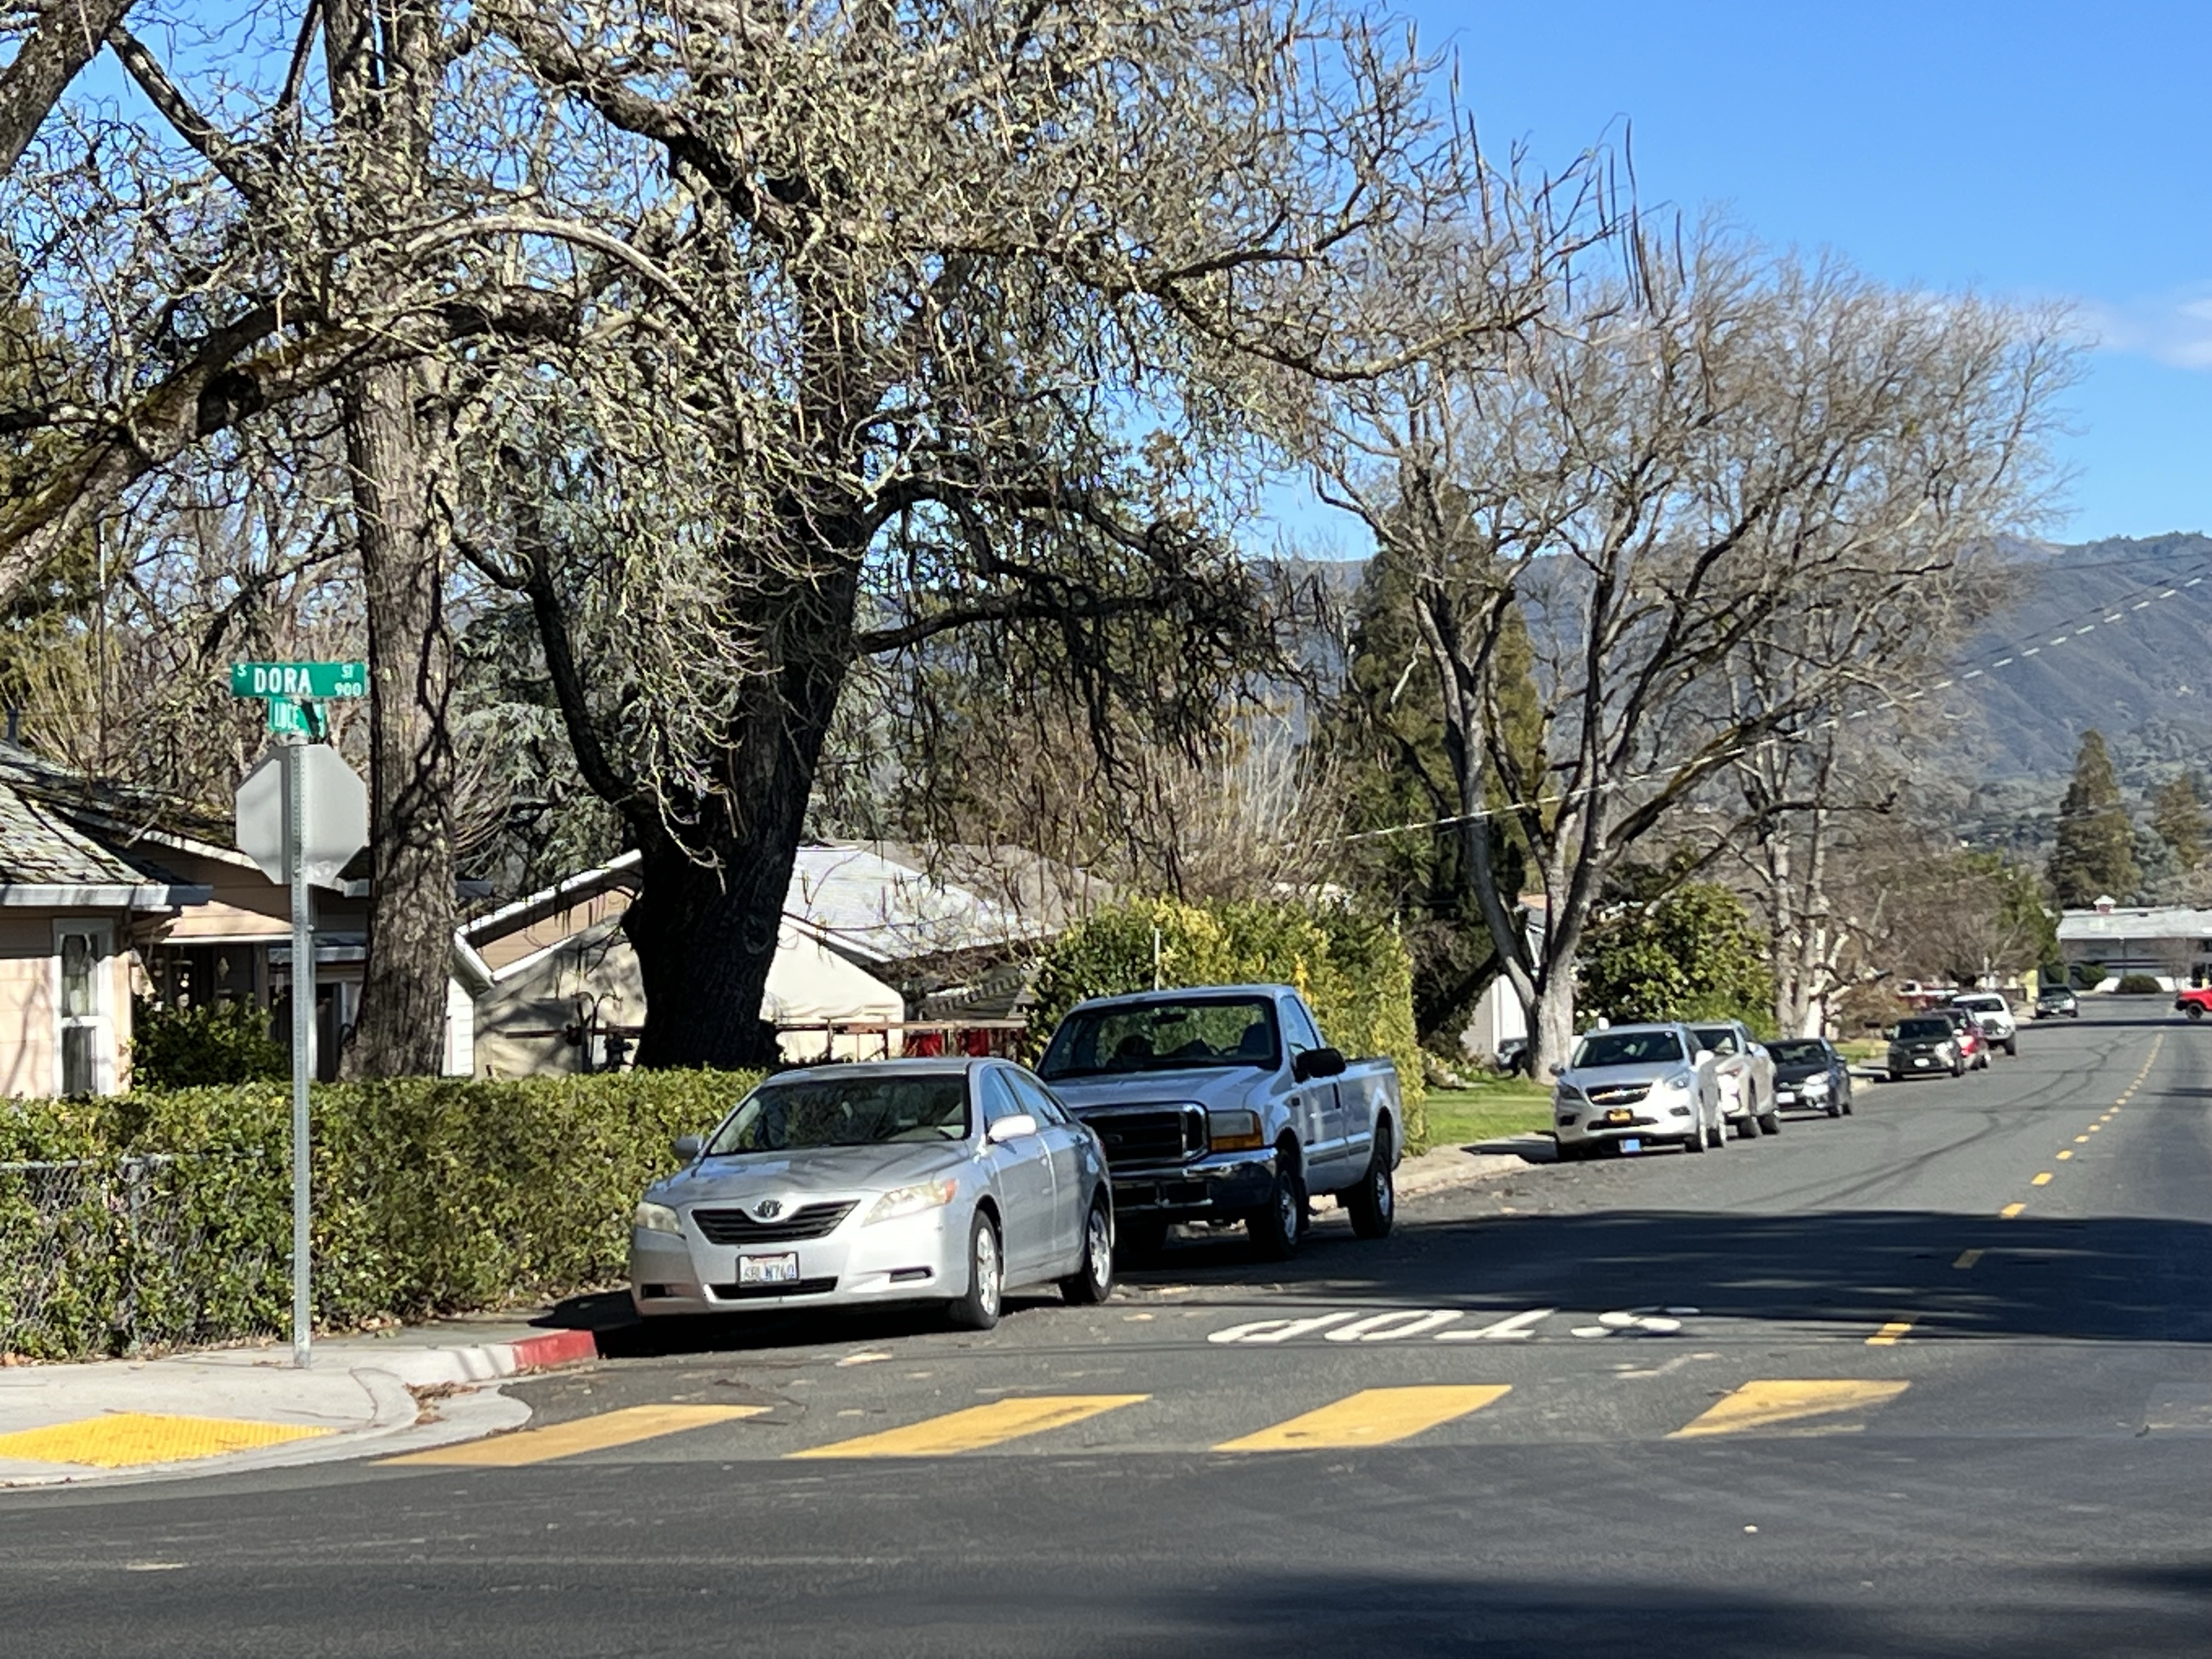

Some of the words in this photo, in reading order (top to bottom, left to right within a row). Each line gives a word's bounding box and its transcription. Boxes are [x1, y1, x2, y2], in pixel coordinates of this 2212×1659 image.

[237, 664, 247, 678] S
[253, 667, 313, 694] DORA
[334, 682, 362, 697] 900
